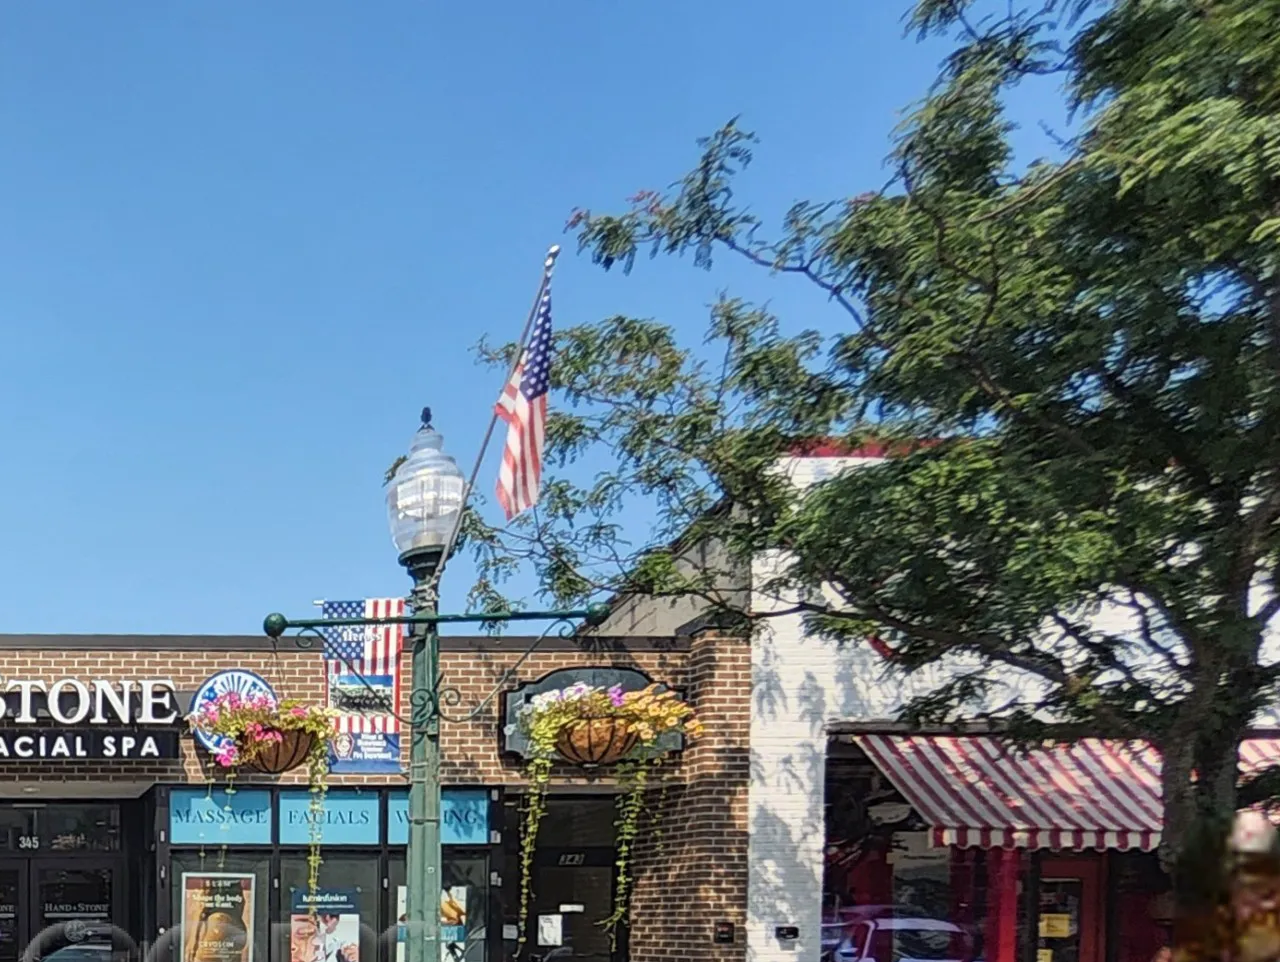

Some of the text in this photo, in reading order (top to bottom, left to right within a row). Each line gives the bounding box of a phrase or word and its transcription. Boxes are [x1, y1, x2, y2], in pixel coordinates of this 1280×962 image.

[102, 735, 160, 757] SPA
[174, 809, 268, 825] MASSAGE
[288, 809, 370, 825] FACIALS
[395, 809, 478, 825] WING
[18, 836, 40, 849] 345
[44, 903, 72, 912] HAND
